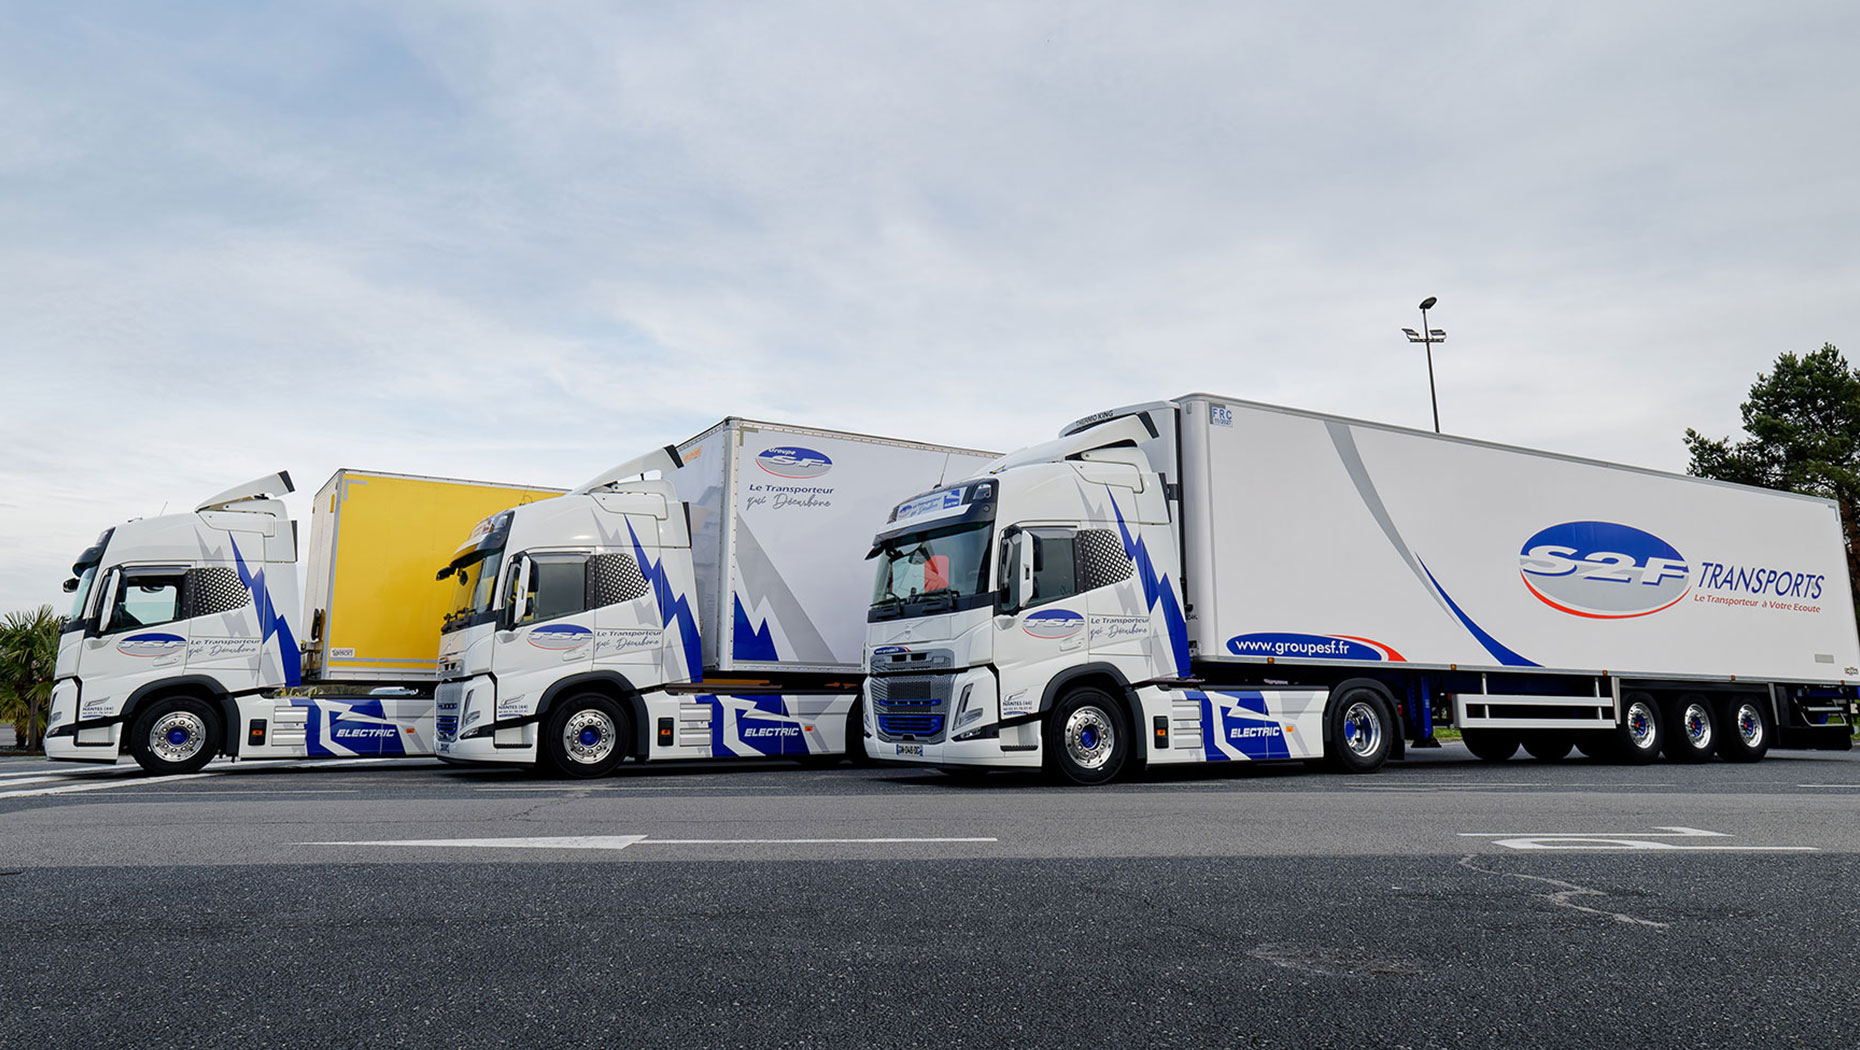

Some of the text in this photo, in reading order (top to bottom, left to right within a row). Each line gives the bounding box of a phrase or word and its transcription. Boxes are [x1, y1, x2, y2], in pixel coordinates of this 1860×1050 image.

[1097, 409, 1114, 420] KING
[1212, 408, 1233, 420] FRC
[769, 456, 826, 468] SF
[766, 484, 834, 494] Transporteur
[746, 495, 767, 511] qui
[1521, 545, 1690, 586] S2F
[1698, 562, 1825, 600] TRANSPORTS
[1694, 593, 1821, 613] Le Transporteur à Votre Ecoute
[609, 630, 662, 639] Transporteur
[1235, 640, 1350, 656] www.groupesf.fr
[336, 728, 396, 738] ELECTRIC
[744, 727, 800, 737] ELECTRIC
[1230, 727, 1280, 738] ELECTRIC
